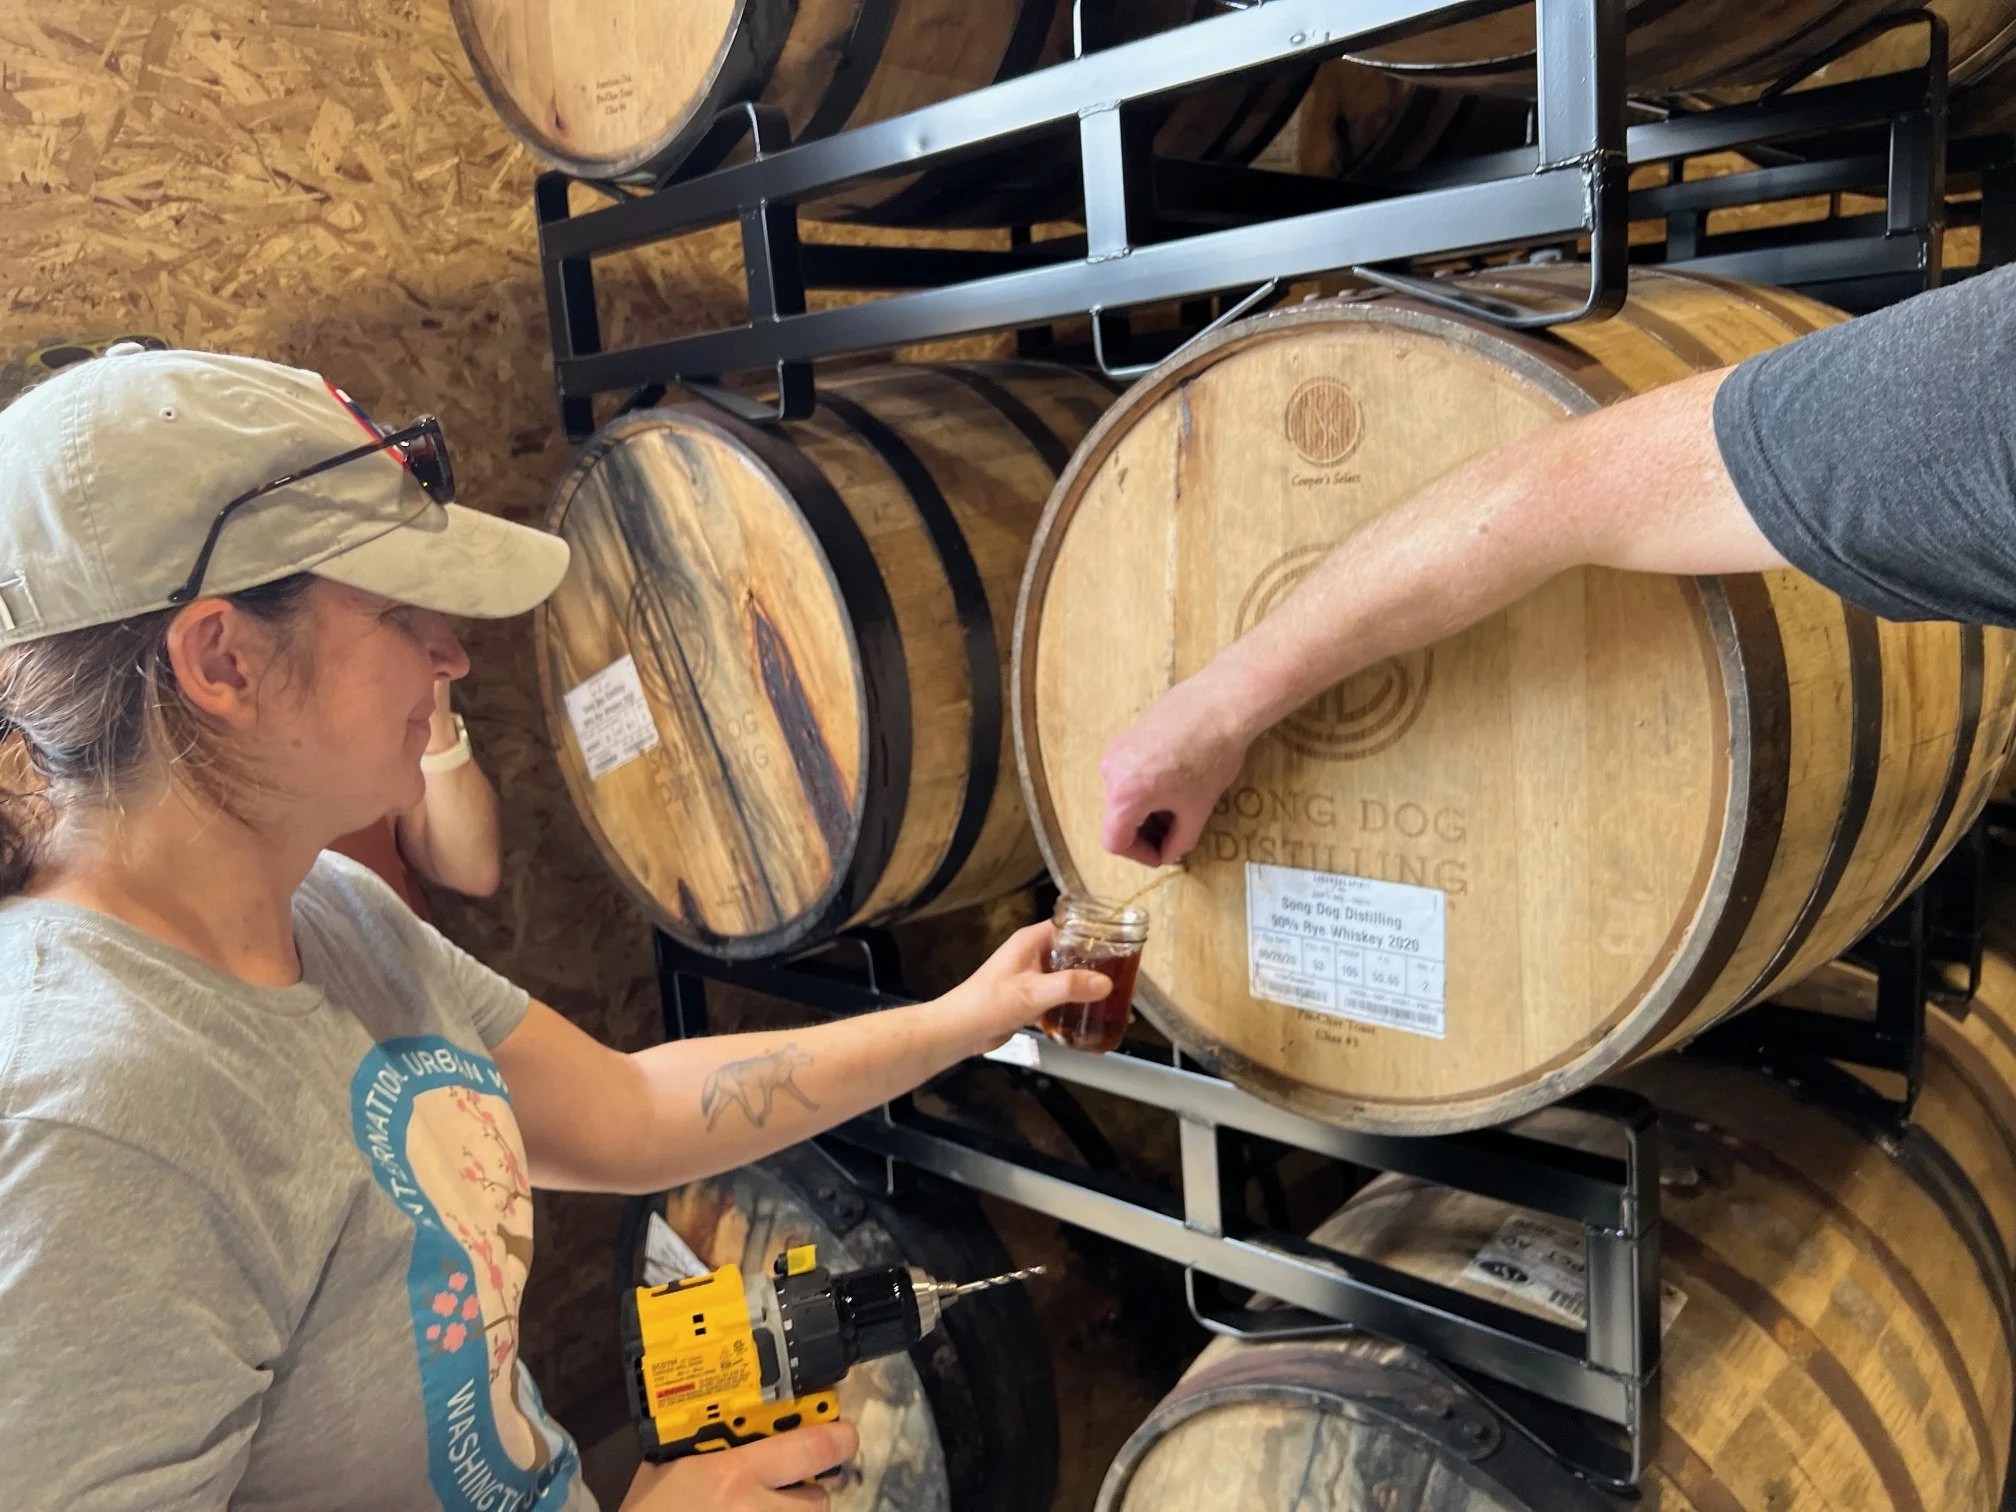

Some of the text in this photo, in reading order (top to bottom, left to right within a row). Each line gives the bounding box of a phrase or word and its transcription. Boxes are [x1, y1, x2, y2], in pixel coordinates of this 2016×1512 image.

[1291, 473, 1361, 490] Cooper's Select
[1360, 798, 1467, 846] DOG
[1281, 896, 1312, 915] Song
[1316, 901, 1341, 920] Dog
[1345, 906, 1403, 931] Distilling
[1302, 920, 1326, 937] Rye
[1330, 925, 1384, 947] Whiskey
[1388, 934, 1420, 952] 2020
